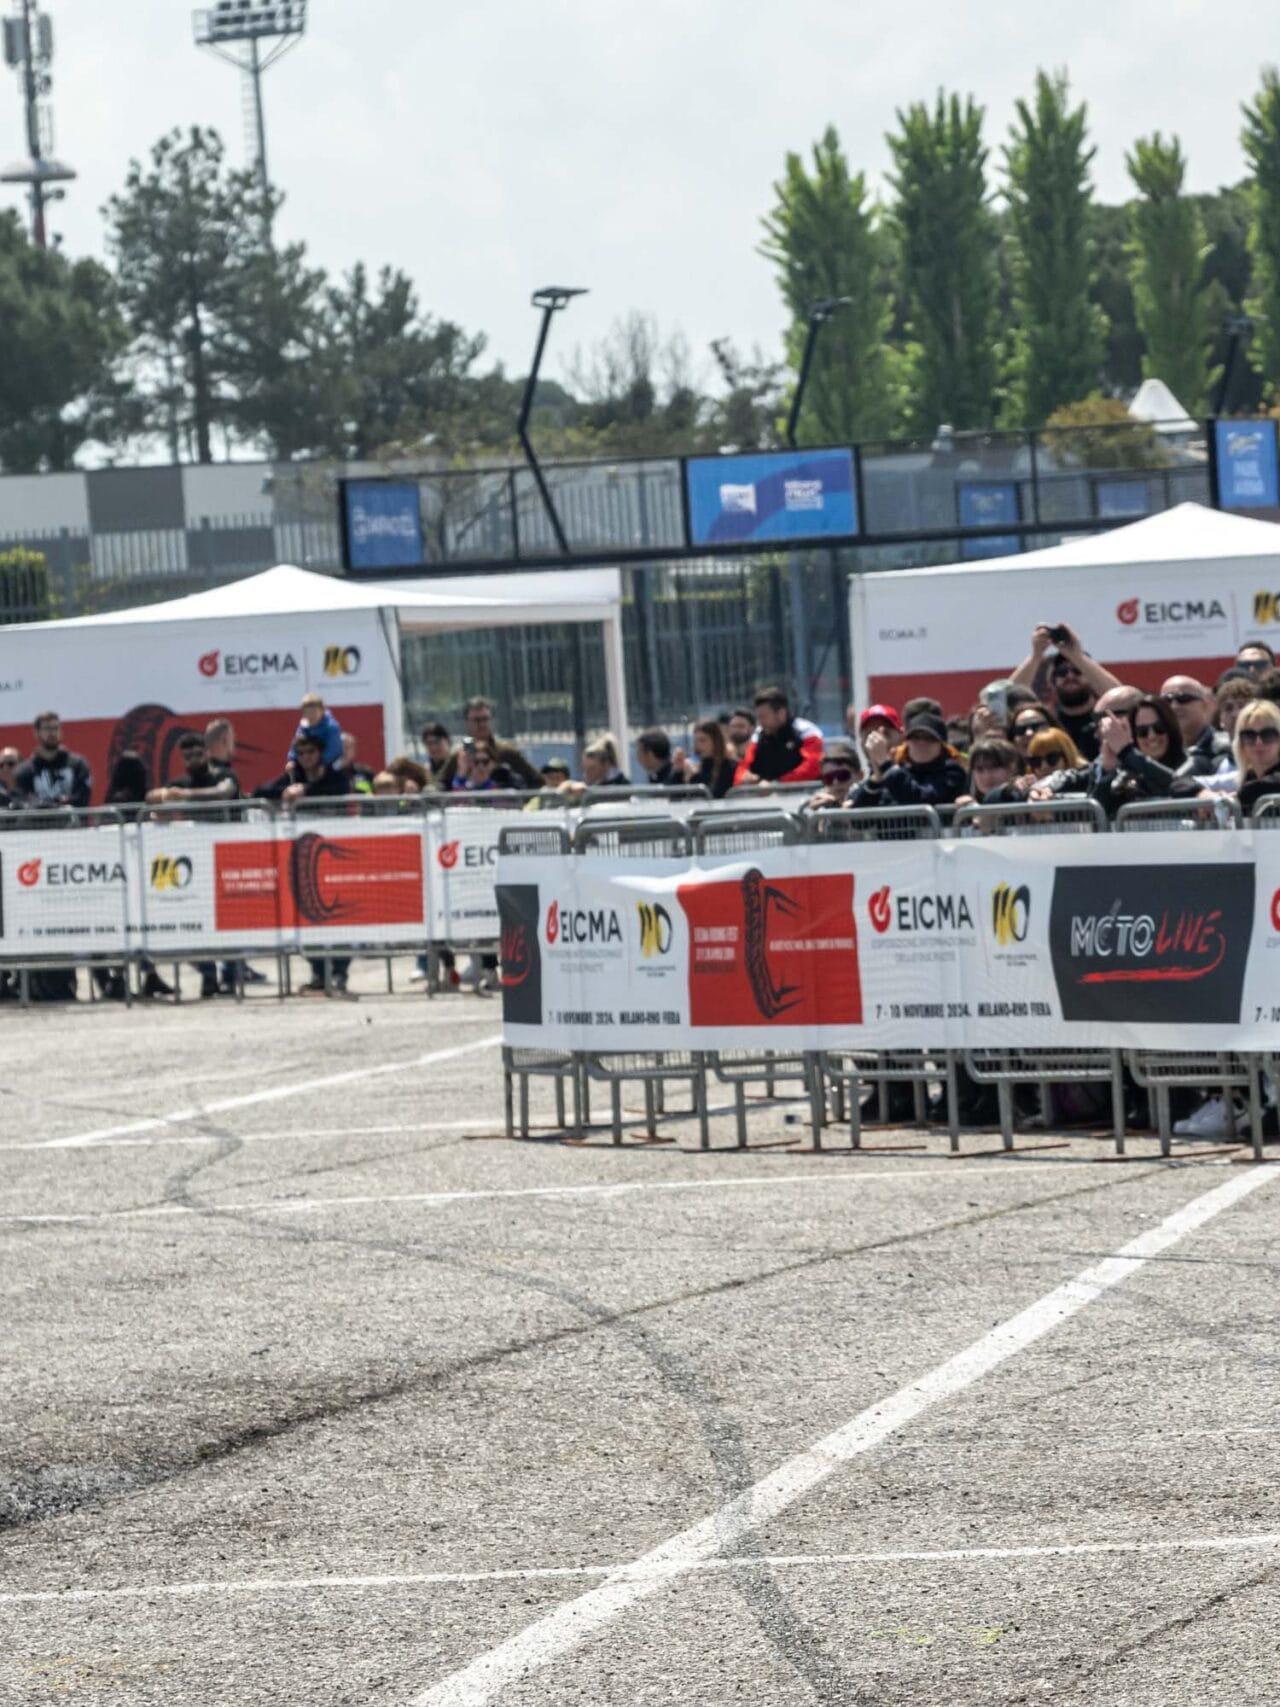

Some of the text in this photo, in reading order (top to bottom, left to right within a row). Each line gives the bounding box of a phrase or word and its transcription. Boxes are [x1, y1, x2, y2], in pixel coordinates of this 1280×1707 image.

[1144, 600, 1226, 623] EICMA
[224, 653, 299, 675] EICMA
[464, 844, 498, 866] EIC
[46, 862, 128, 885] EICMA
[897, 894, 974, 931] EICMA
[560, 909, 622, 943] EICMA
[1255, 1007, 1263, 1022] 7
